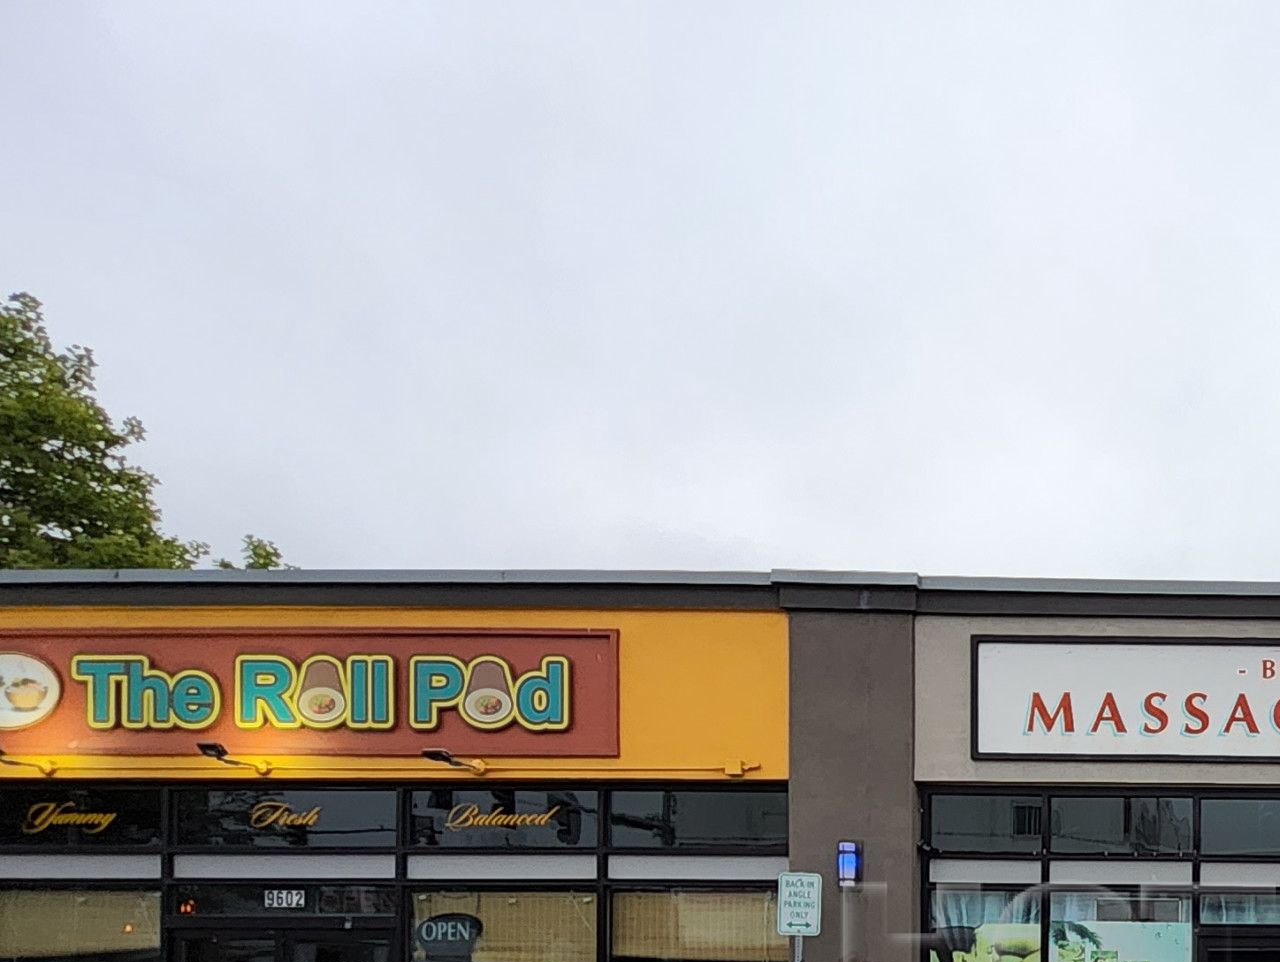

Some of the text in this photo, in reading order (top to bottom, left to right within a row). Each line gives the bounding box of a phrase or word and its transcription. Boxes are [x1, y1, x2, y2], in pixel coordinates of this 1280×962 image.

[72, 655, 570, 729] The Roll Pod
[22, 801, 117, 833] Yummy
[250, 801, 322, 828] Fresh
[445, 802, 561, 831] Balanced
[785, 880, 805, 888] BACK
[266, 890, 304, 906] 9602
[788, 891, 811, 899] ANGLE
[784, 901, 815, 909] PARKING
[790, 911, 809, 919] ONLY
[421, 921, 470, 941] OPEN
